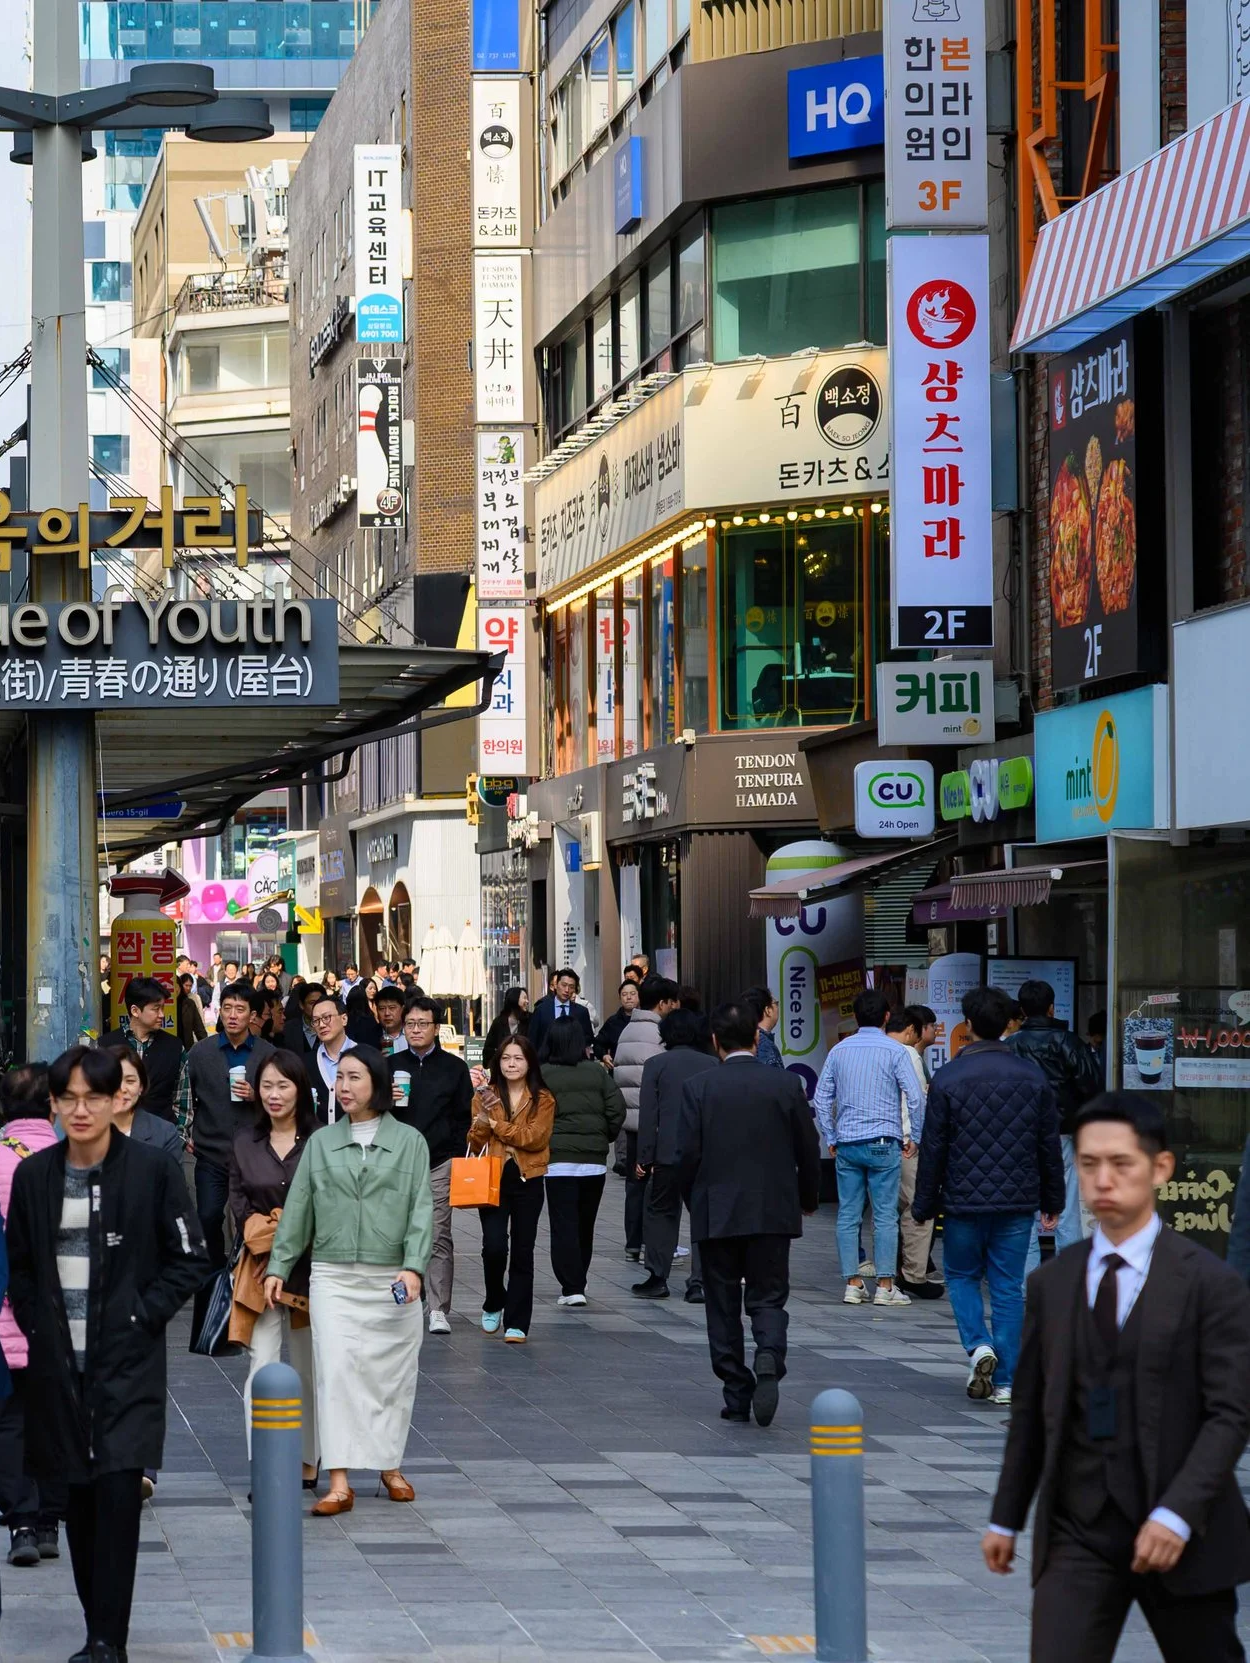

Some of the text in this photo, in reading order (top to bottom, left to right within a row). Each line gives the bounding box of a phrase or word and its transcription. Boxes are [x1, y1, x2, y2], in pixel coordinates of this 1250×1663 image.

[806, 82, 871, 132] HQ
[904, 37, 935, 161] 한의원
[940, 37, 973, 161] 본라인
[477, 206, 518, 219] 돈카츠
[918, 180, 962, 212] 3F
[482, 298, 514, 371] 天丼
[824, 382, 871, 409] 백소정
[1069, 339, 1130, 419] 샹츠마라
[387, 386, 399, 422] ROCK
[774, 391, 808, 430] 百
[778, 457, 849, 491] 돈카츠
[920, 359, 966, 560] 샹츠마라
[380, 495, 398, 510] 4F
[104, 484, 249, 569] 거리
[482, 491, 500, 574] 부대찌개
[502, 493, 523, 574] 오겹살
[58, 584, 124, 647] of
[132, 581, 312, 645] Youth
[923, 609, 967, 640] 2F
[484, 616, 519, 655] 약
[1083, 624, 1103, 679] 2F
[895, 671, 981, 715] 커피
[482, 739, 523, 755] 한의원
[942, 724, 962, 734] mint
[735, 753, 797, 771] TENDON
[735, 772, 804, 789] TENPURA
[1066, 756, 1092, 801] mint
[735, 792, 799, 808] HAMADA
[877, 782, 913, 802] CU
[126, 808, 149, 817] 15-gil
[878, 820, 920, 831] 24h Open
[117, 932, 175, 966] 짬뽕
[789, 966, 807, 1040] Nice to
